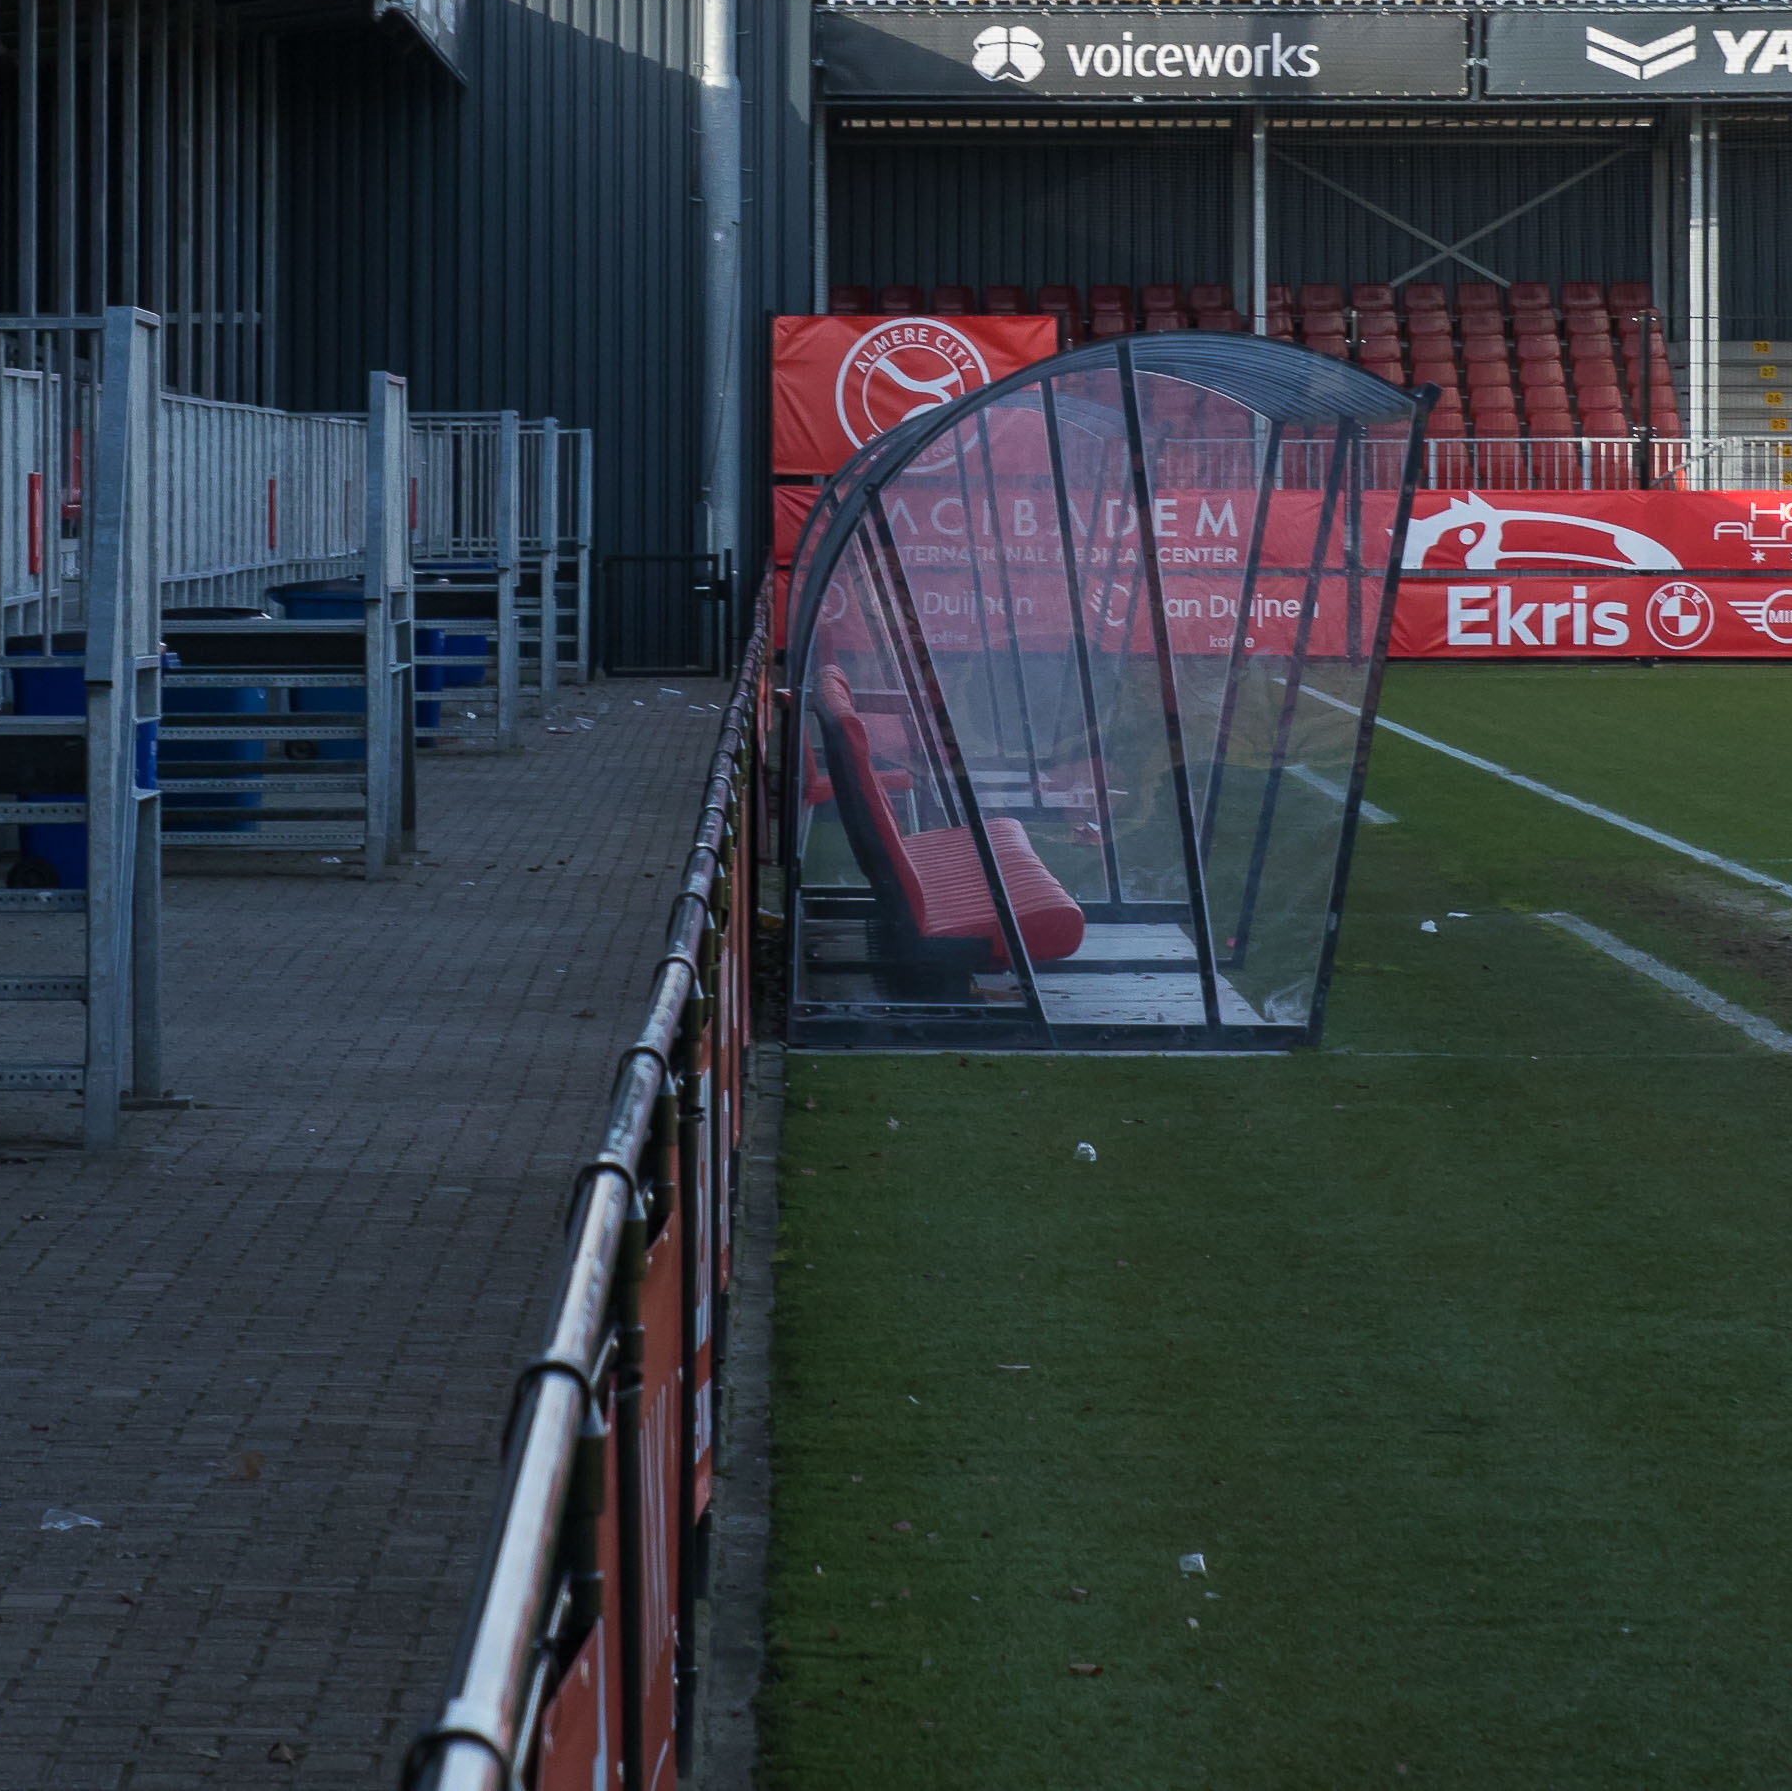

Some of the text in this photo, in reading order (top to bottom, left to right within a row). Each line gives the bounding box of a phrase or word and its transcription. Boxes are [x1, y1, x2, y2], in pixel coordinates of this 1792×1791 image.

[1066, 31, 1321, 78] voiceworks
[853, 327, 977, 374] ALMERE CITY
[1158, 546, 1239, 563] CENTER
[1164, 598, 1203, 619] an
[1447, 585, 1630, 646] Ekris
